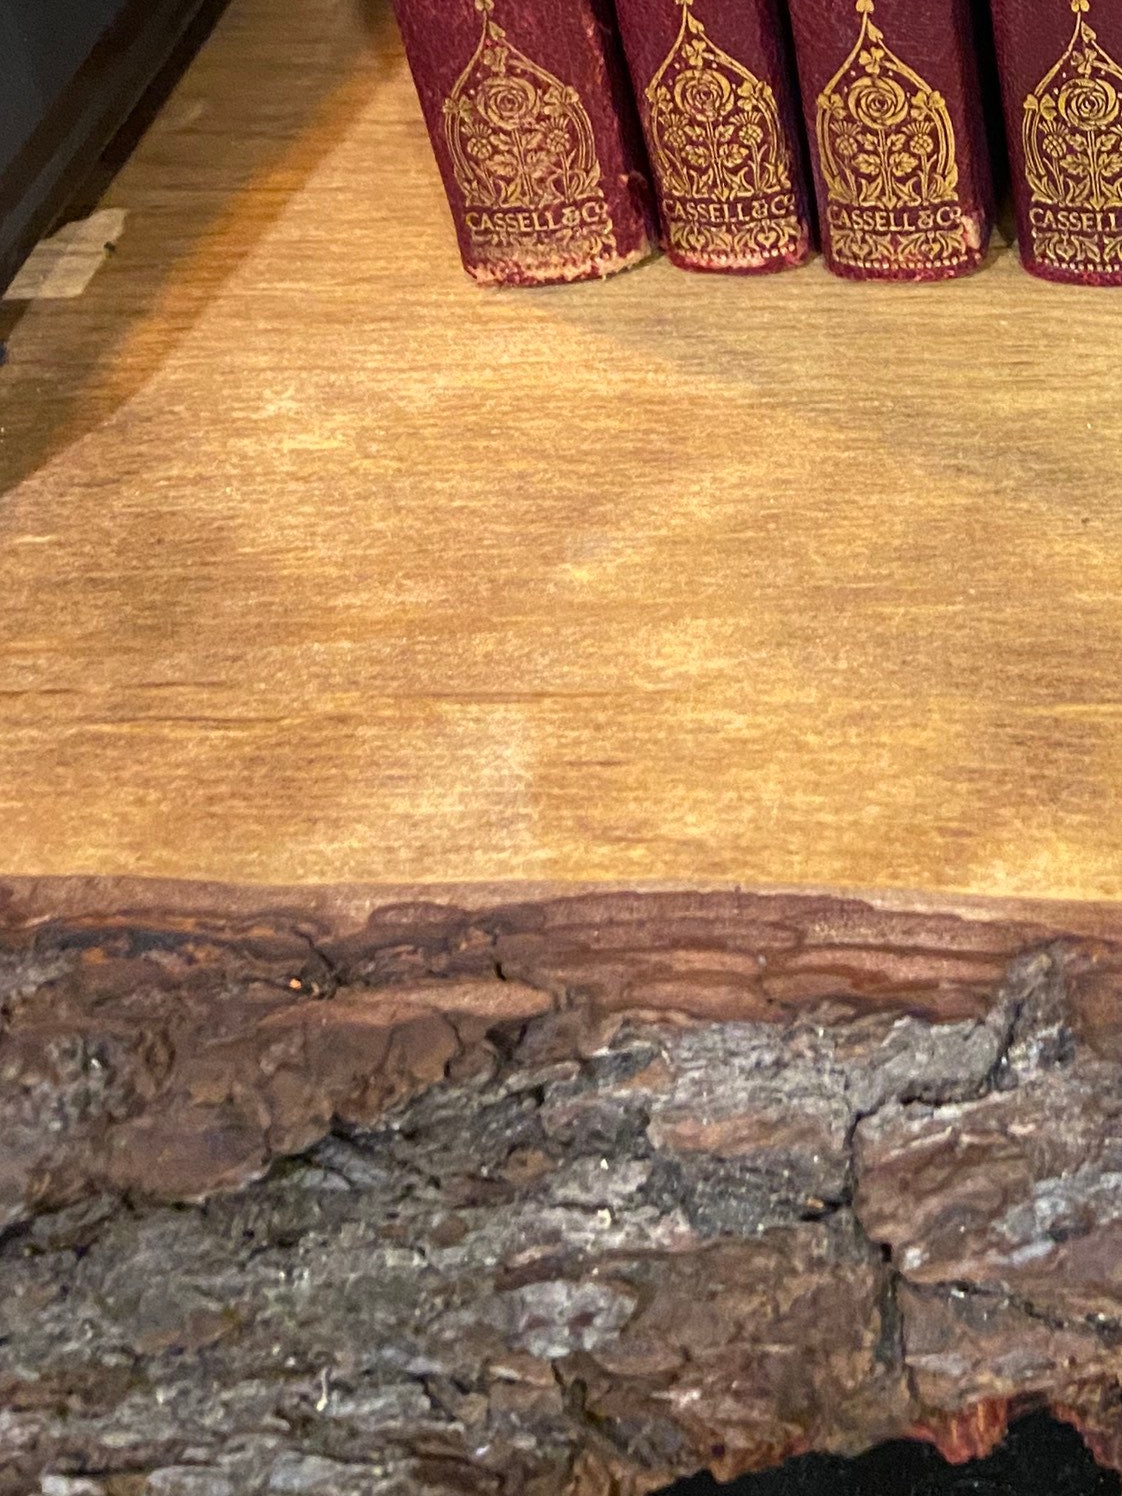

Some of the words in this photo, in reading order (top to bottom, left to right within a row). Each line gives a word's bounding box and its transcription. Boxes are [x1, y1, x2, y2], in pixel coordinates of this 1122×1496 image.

[466, 211, 560, 232] CASSELL
[562, 206, 580, 227] &
[662, 199, 750, 222] CASSELL
[752, 198, 769, 219] &
[827, 206, 915, 231] CASSELL
[917, 207, 935, 227] &
[1029, 208, 1121, 232] CASSELL
